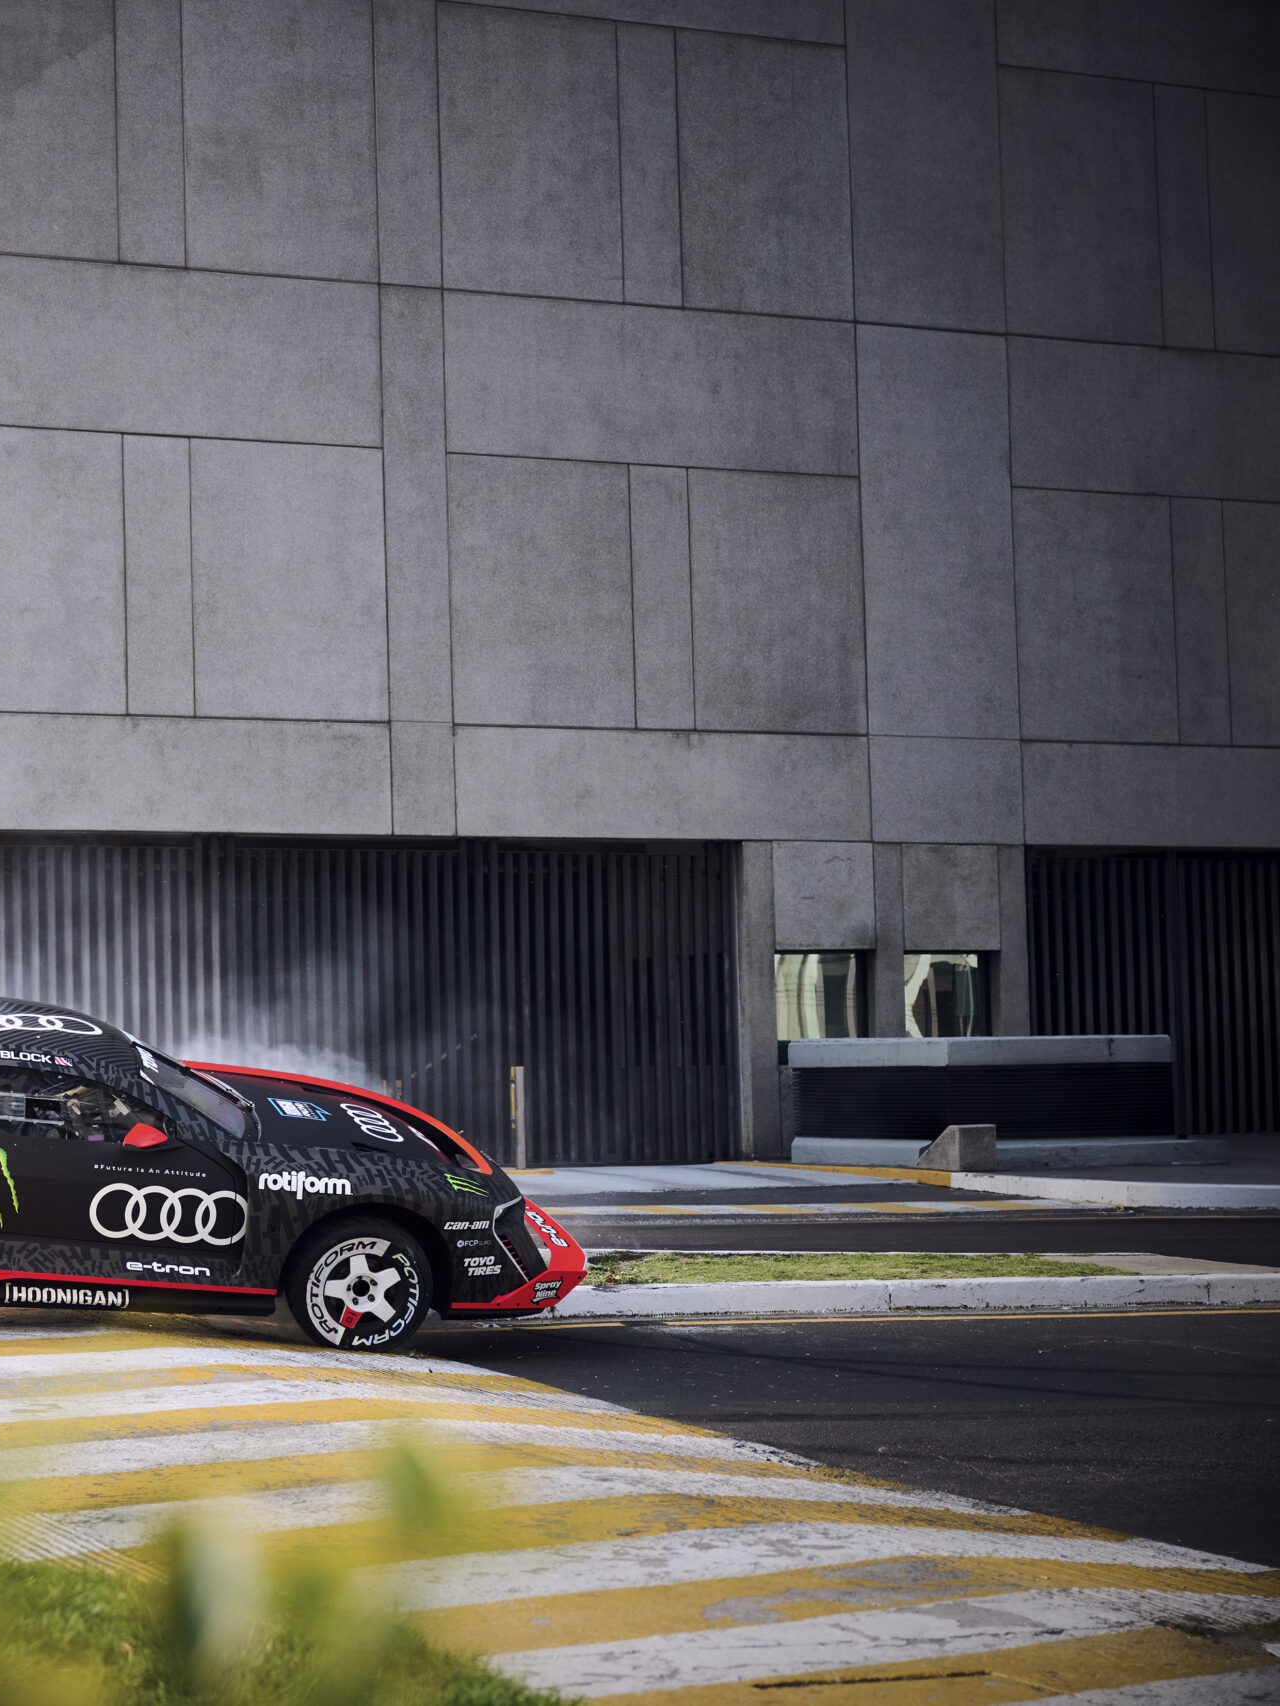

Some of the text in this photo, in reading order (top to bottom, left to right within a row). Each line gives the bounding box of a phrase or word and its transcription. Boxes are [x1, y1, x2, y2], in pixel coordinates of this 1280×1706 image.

[0, 1050, 53, 1064] BLOCK
[93, 1164, 133, 1173] #Future
[164, 1169, 207, 1178] Attitude
[258, 1170, 353, 1200] rotiform
[443, 1220, 491, 1231] can-am
[464, 1239, 479, 1247] FCP
[463, 1256, 496, 1267] TOYO
[126, 1261, 211, 1277] e-tron
[467, 1265, 502, 1277] TIRES
[310, 1240, 378, 1335] ROTIFORM
[534, 1280, 563, 1291] Spray
[351, 1252, 420, 1346] ROTIFORM
[535, 1289, 557, 1298] Nine
